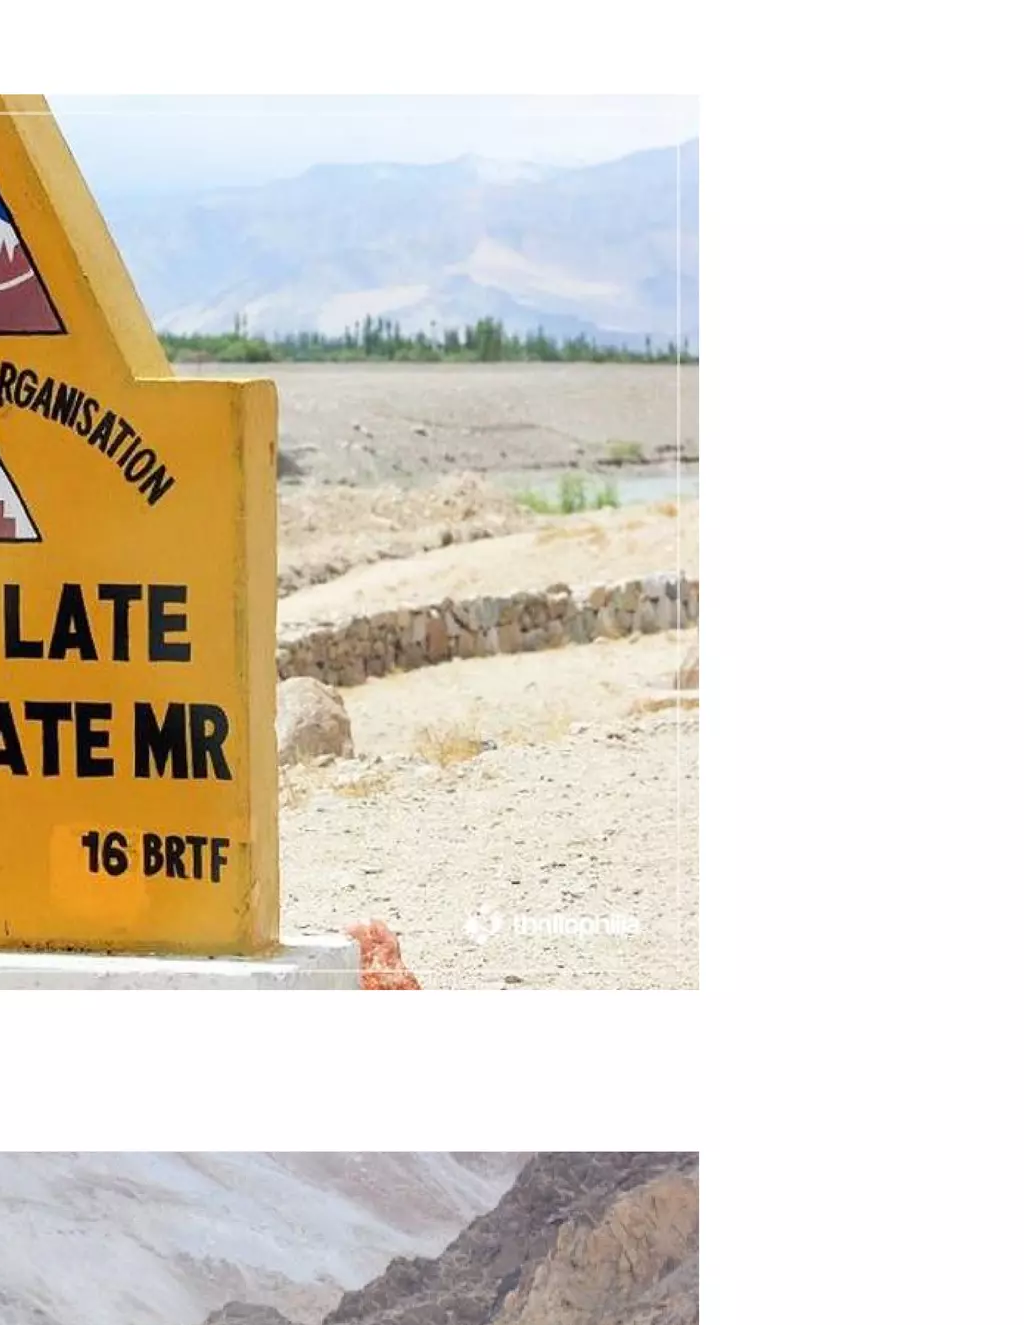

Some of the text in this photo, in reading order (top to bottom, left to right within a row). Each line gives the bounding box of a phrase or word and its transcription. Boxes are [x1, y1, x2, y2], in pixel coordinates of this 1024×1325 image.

[3, 584, 192, 663] LATE
[134, 702, 233, 780] MR
[81, 832, 230, 883] 16 BRTF
